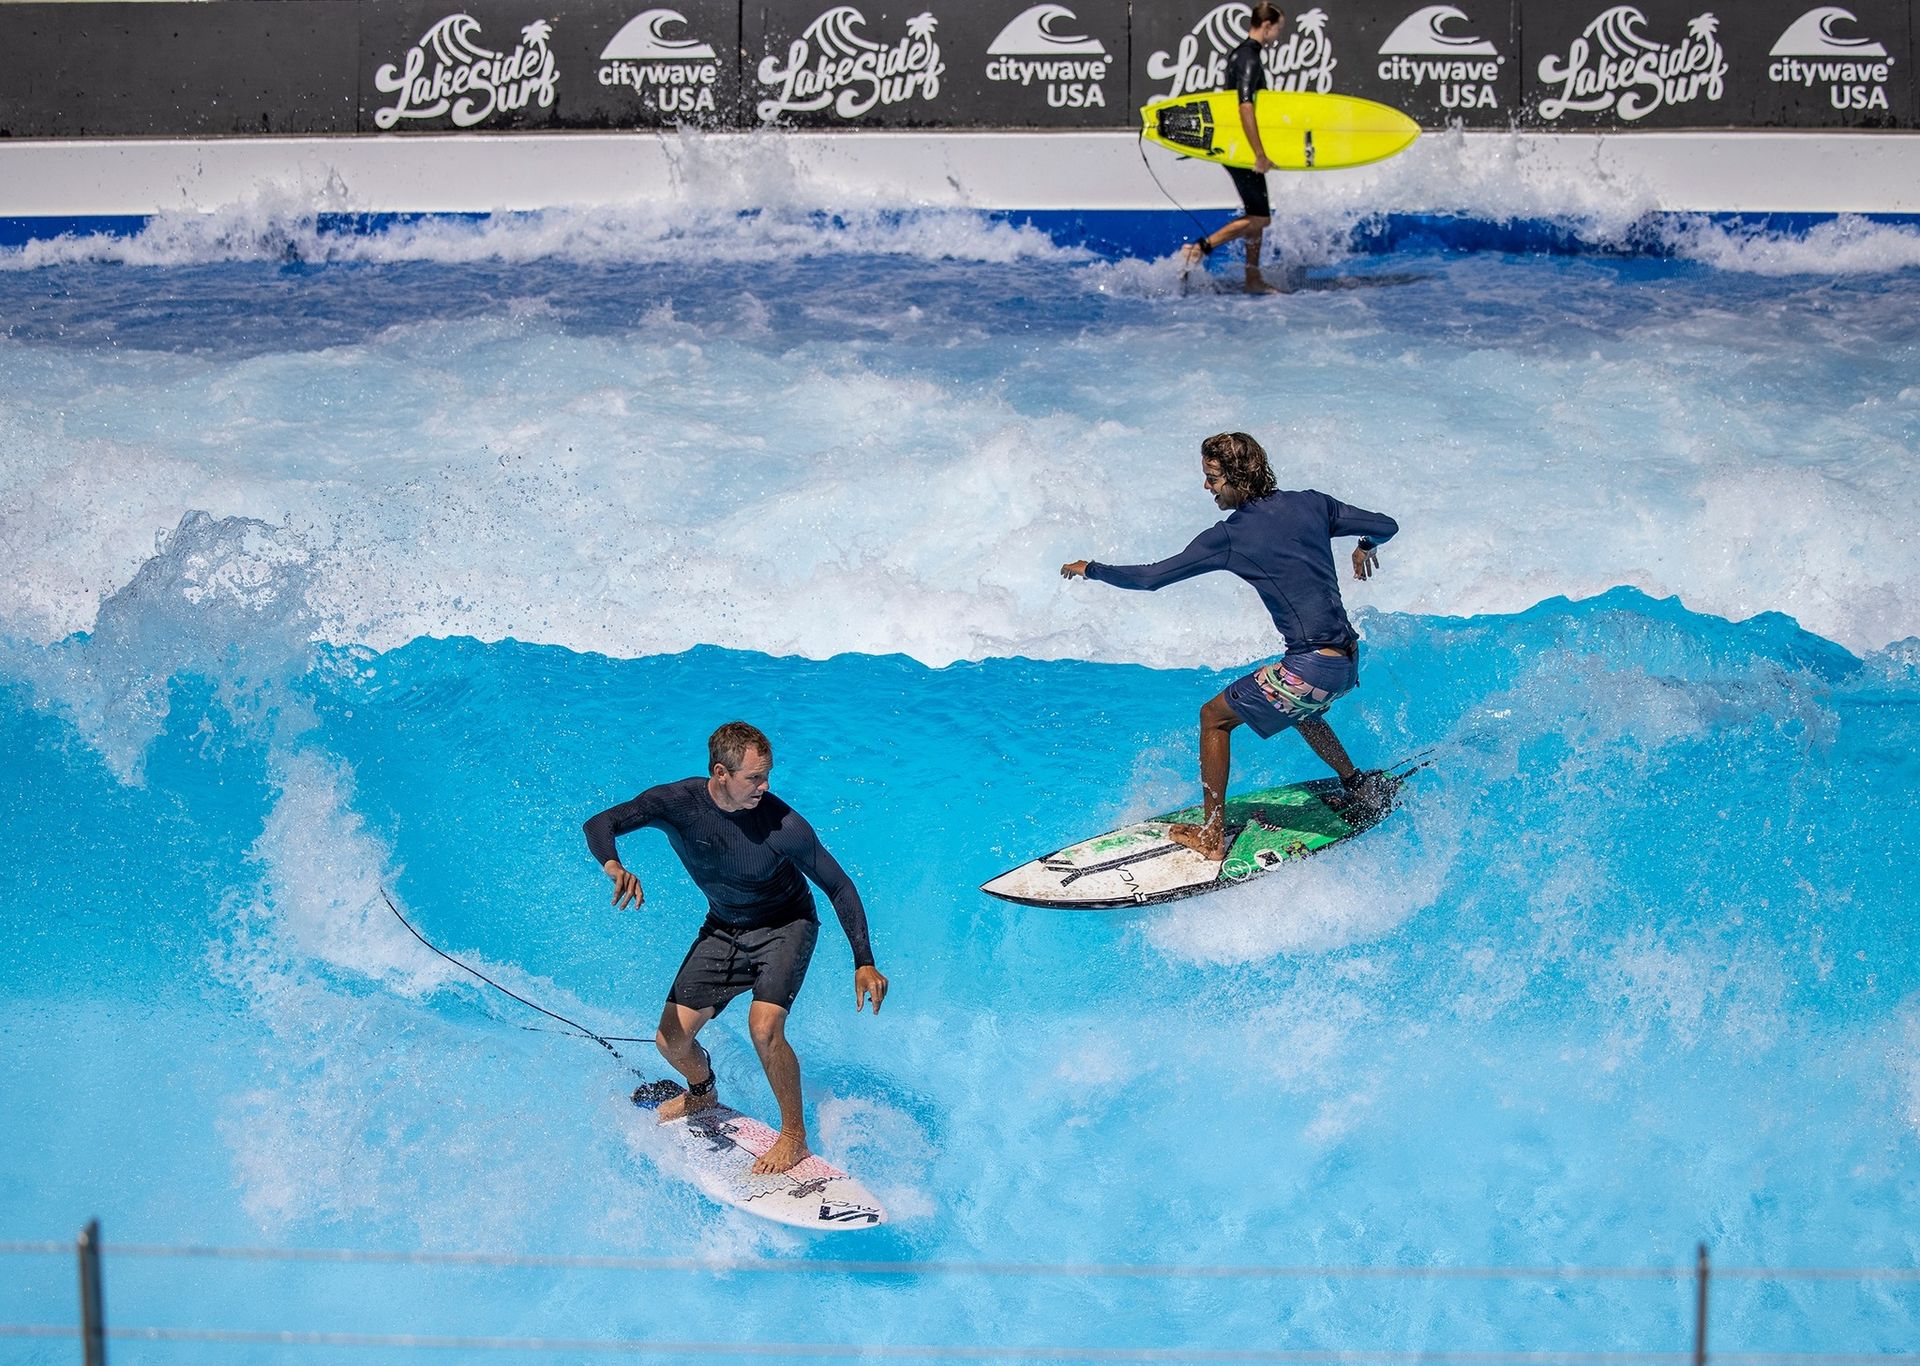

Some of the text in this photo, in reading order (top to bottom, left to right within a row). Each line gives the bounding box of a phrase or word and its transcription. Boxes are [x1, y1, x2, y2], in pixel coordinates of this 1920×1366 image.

[659, 87, 716, 112] USA
[1047, 84, 1106, 108] USA
[1440, 84, 1498, 109] USA
[1831, 85, 1889, 110] USA
